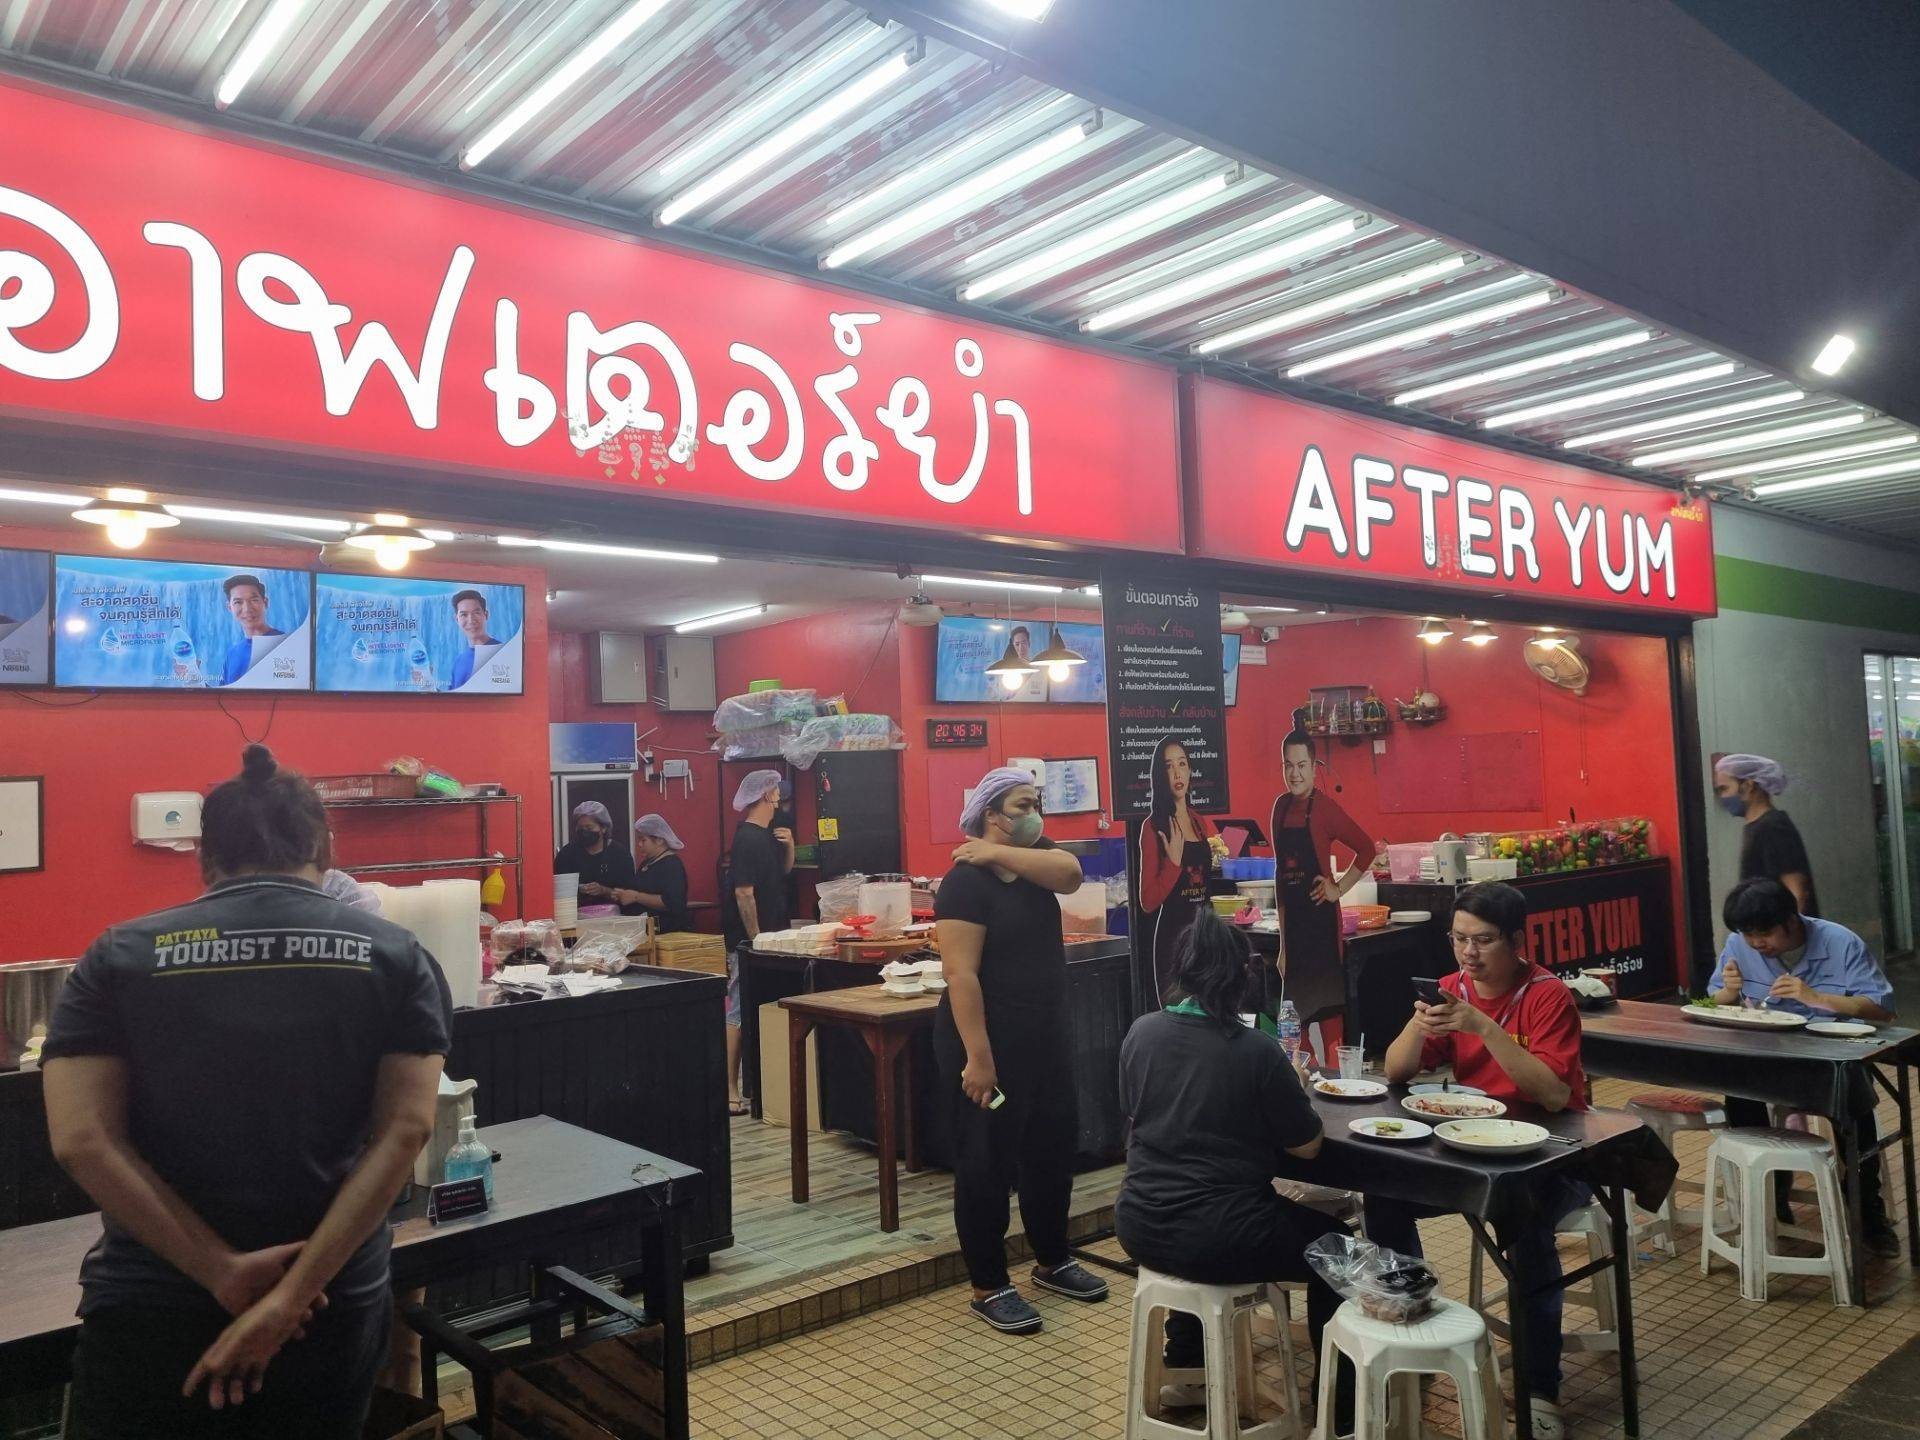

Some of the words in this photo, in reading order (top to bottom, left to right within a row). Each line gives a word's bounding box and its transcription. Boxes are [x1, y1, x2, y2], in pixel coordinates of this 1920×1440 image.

[0, 184, 1033, 516] อาฟเตอร์ยำ
[1284, 443, 1540, 582] AFTER
[1552, 498, 1677, 600] YUM
[80, 590, 159, 607] สะอาดสดชื่น
[1125, 582, 1200, 608] ขั้นตอนการสั่ง
[99, 606, 182, 624] จนคุณรู้สึกได้
[336, 604, 400, 620] สะอาดสดชื่น
[935, 724, 950, 737] 20
[155, 928, 219, 947] PATTAYA
[1516, 906, 1586, 965] FTER
[1588, 896, 1642, 955] YUM
[154, 936, 276, 967] TOURIST
[284, 936, 373, 962] POLICE
